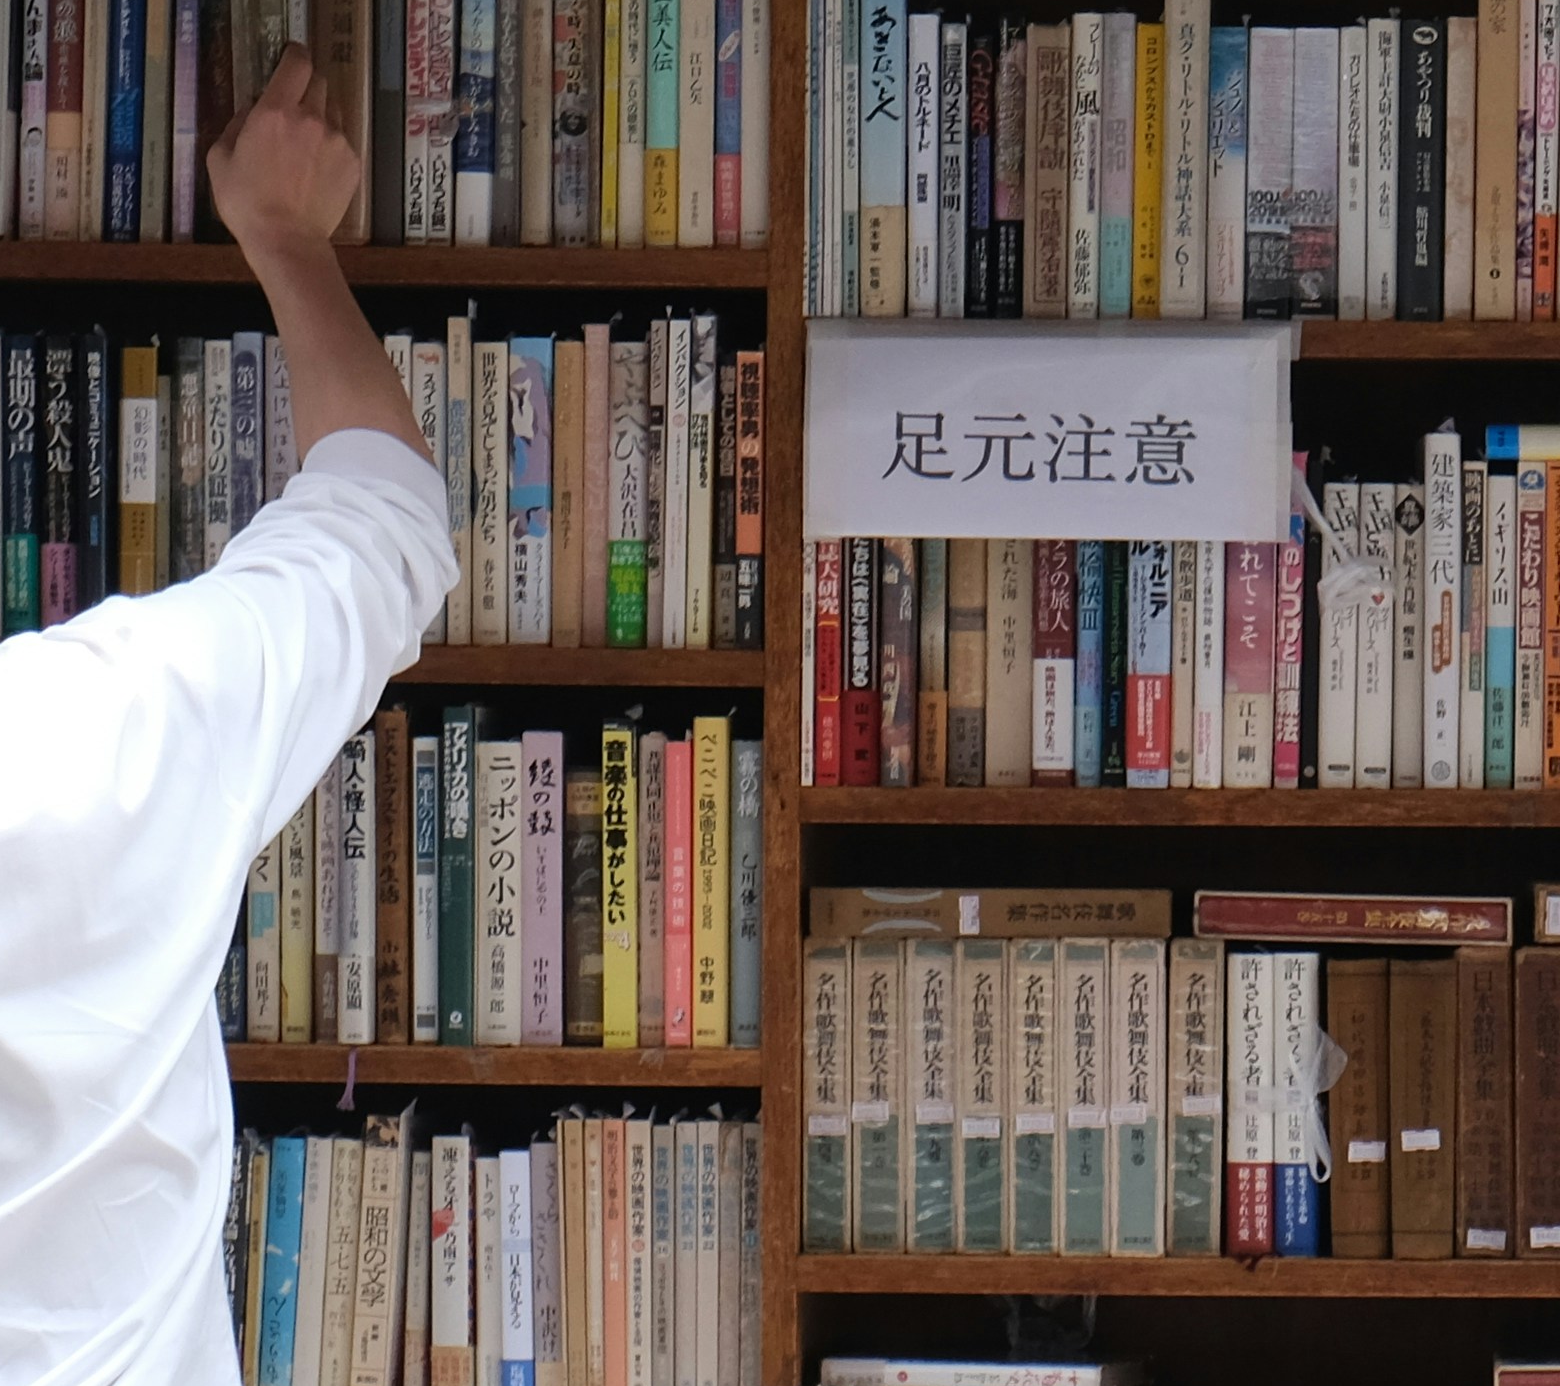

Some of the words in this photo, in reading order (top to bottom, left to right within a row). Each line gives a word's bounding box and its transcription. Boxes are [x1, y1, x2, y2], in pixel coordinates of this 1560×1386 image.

[914, 62, 932, 153] 八月のトルネード
[942, 43, 962, 145] 巨匠のメチエ
[1175, 23, 1194, 239] 真ク・リトル・リトル神話大系
[1415, 49, 1433, 139] あやつり裁判
[7, 348, 36, 460] 最期の声
[46, 350, 73, 473] 漂う殺人鬼
[674, 329, 687, 411] インパクション
[133, 407, 148, 481] 幻影の時代
[208, 384, 229, 524] ふたりの証拠
[740, 363, 760, 516] 視聴率男の発想術
[882, 411, 1197, 485] 足元注意
[619, 465, 638, 538] 大沢在昌
[1431, 452, 1455, 586] 建築家三代
[1464, 472, 1481, 562] 映画のあとに
[1493, 498, 1508, 608] イギリス山
[514, 543, 528, 605] 横山秀夫
[1237, 699, 1258, 763] 江上剛
[487, 754, 517, 938] ニッポンの小説
[528, 756, 555, 837] 綾の鼓
[604, 741, 629, 926] 音楽の仕事がしたい
[740, 855, 757, 941] 乙川優三郎
[490, 944, 505, 1015] 高橋源一郎
[533, 958, 548, 1024] 中里恒子
[1241, 959, 1263, 1086] 許されざる者
[815, 972, 837, 1105] 名作歌舞伎全集
[867, 971, 889, 1103] 名作歌舞伎全集
[923, 969, 944, 1101] 名作歌舞伎全集
[971, 972, 994, 1106] 名作歌舞伎全集
[1024, 973, 1045, 1106] 名作歌舞伎全集
[1073, 973, 1096, 1106] 名作歌舞伎全集
[1127, 972, 1148, 1106] 名作歌舞伎全集
[1185, 972, 1207, 1096] 名作歌舞伎全集
[440, 1146, 458, 1212] 凍える牙
[1244, 1114, 1259, 1161] 辻原登
[631, 1143, 646, 1236] 世界の映画作家
[701, 1143, 716, 1237] 世界の映画作家
[360, 1205, 389, 1308] 昭和の文学
